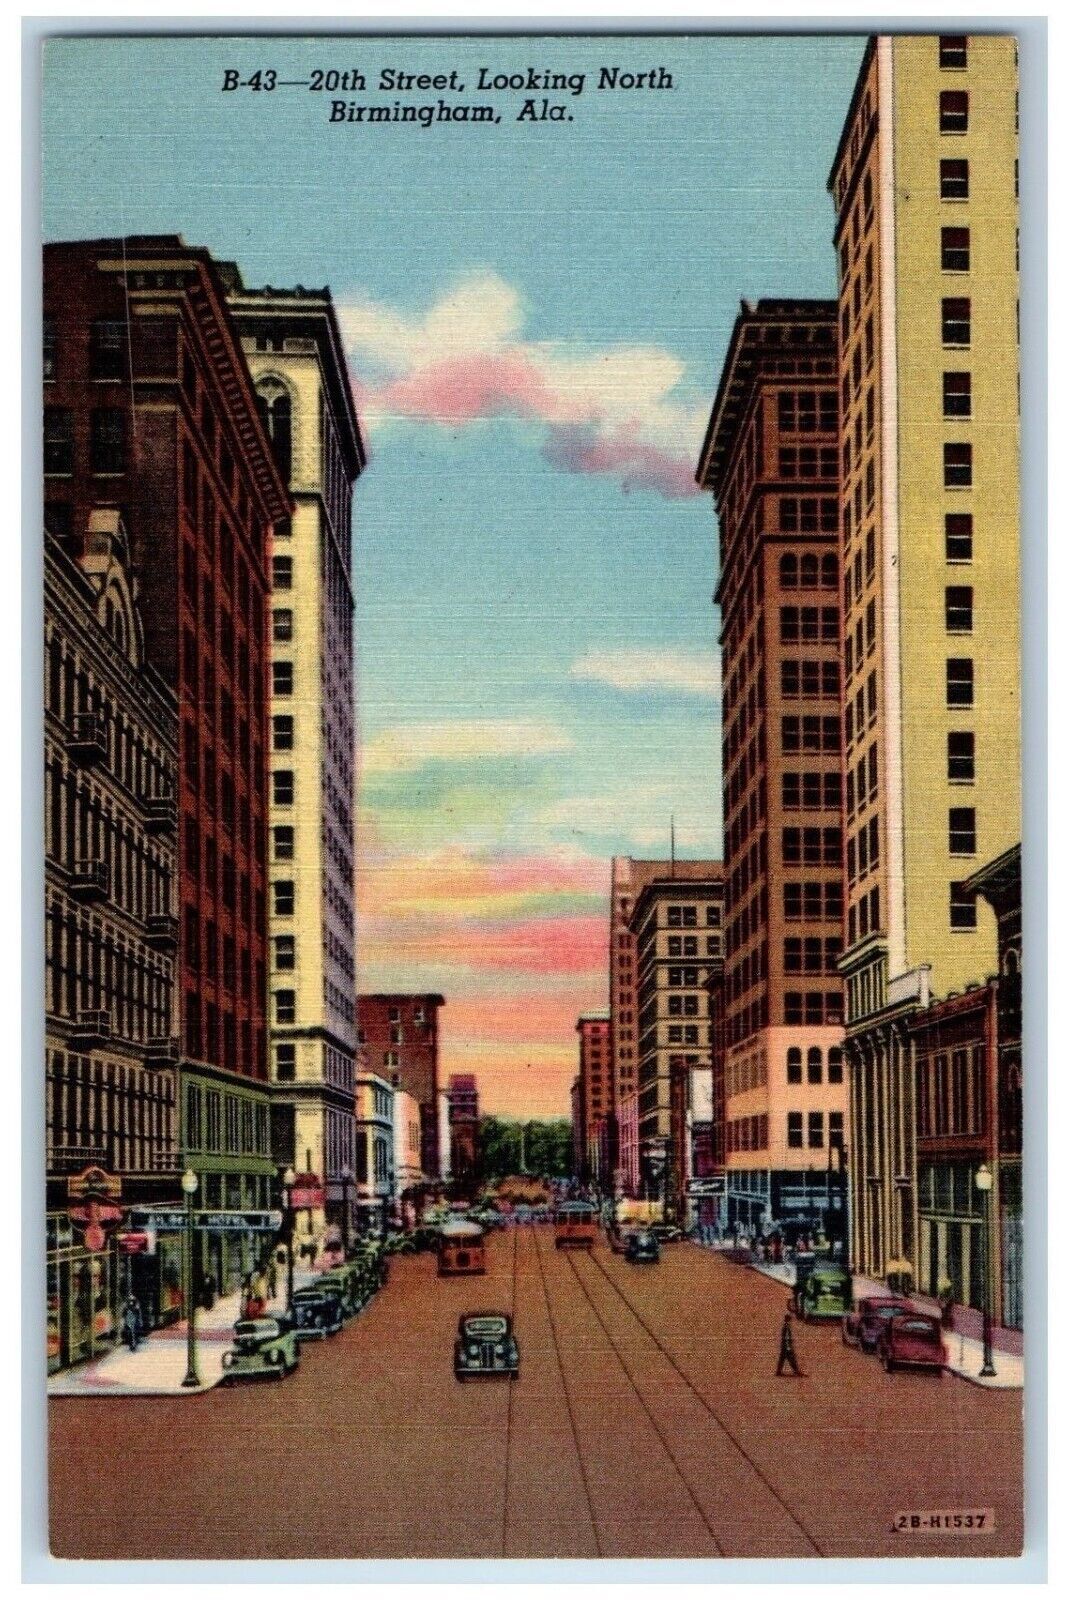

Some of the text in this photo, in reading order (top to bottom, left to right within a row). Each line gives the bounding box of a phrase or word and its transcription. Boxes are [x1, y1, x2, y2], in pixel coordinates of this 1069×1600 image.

[379, 69, 465, 92] Street,
[478, 68, 586, 96] Looking
[598, 67, 673, 90] North
[329, 98, 574, 128] Birmingham, Ala.
[898, 1515, 986, 1529] 2B-H1537
